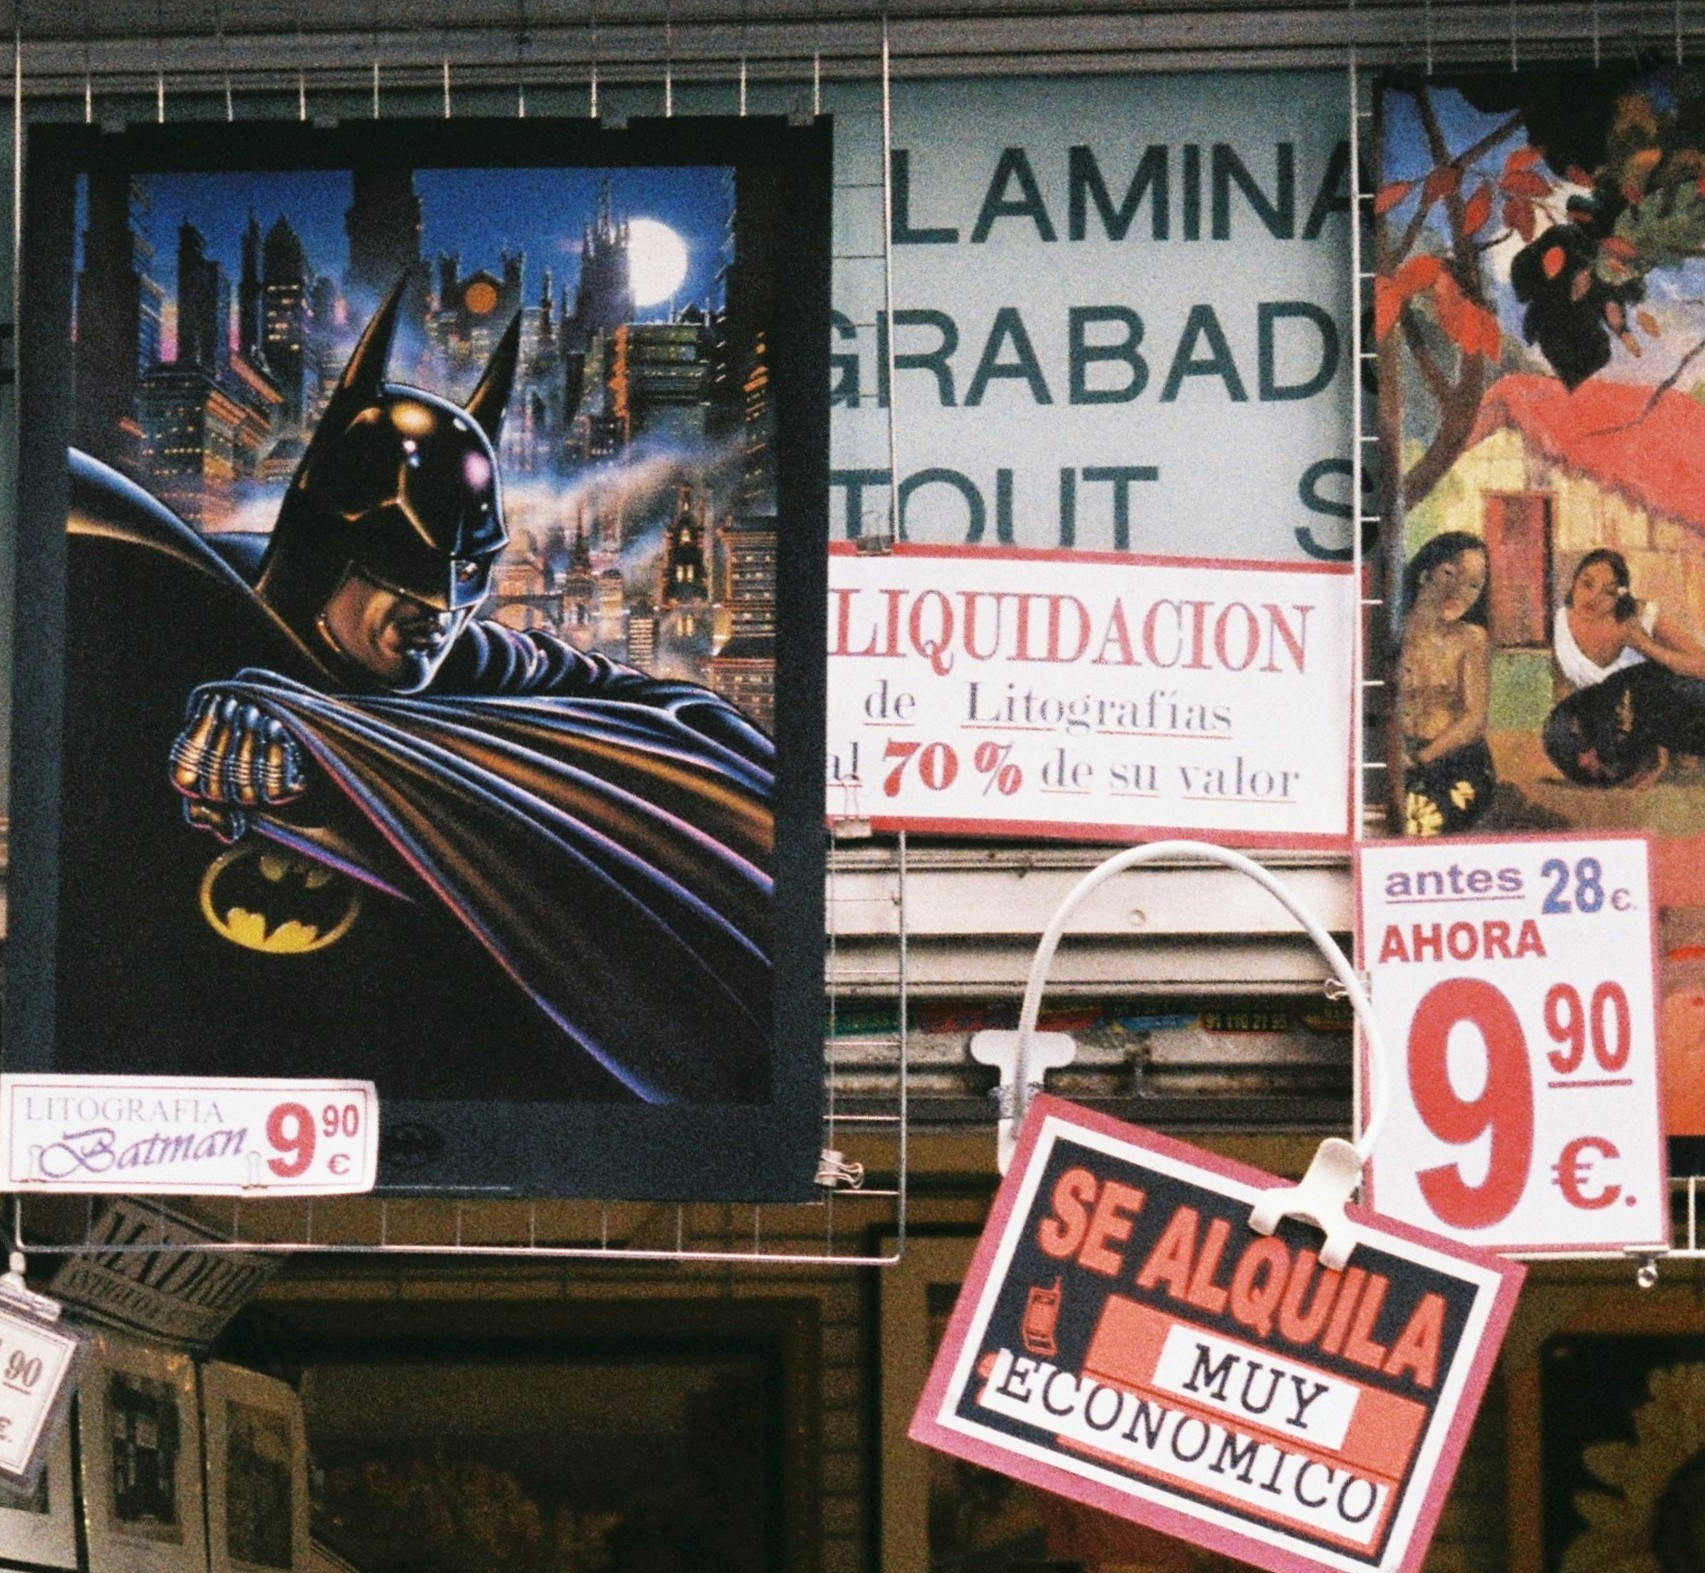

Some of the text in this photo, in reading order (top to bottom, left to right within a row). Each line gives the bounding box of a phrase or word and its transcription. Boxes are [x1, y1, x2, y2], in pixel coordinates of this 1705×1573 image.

[829, 301, 1378, 408] RABAD
[829, 465, 1159, 550] TOUT
[829, 589, 1315, 675] LIQUIDACION
[864, 679, 1233, 735] de Litografías
[881, 738, 959, 798] 70
[974, 740, 1023, 796] %
[1041, 747, 1093, 789] de
[1110, 762, 1159, 793] su
[1180, 757, 1300, 798] valor
[1384, 864, 1525, 897] antes
[1540, 857, 1605, 915] 28
[1378, 919, 1547, 964] AHORA
[25, 1097, 224, 1123] LITOGRAFIA
[39, 1126, 248, 1178] Batman
[327, 1153, 351, 1175] €
[1035, 1165, 1447, 1390] SE ALQUILA
[5, 1350, 42, 1387] 90
[1183, 1342, 1329, 1430] MUY
[996, 1352, 1378, 1523] ECONOMICO
